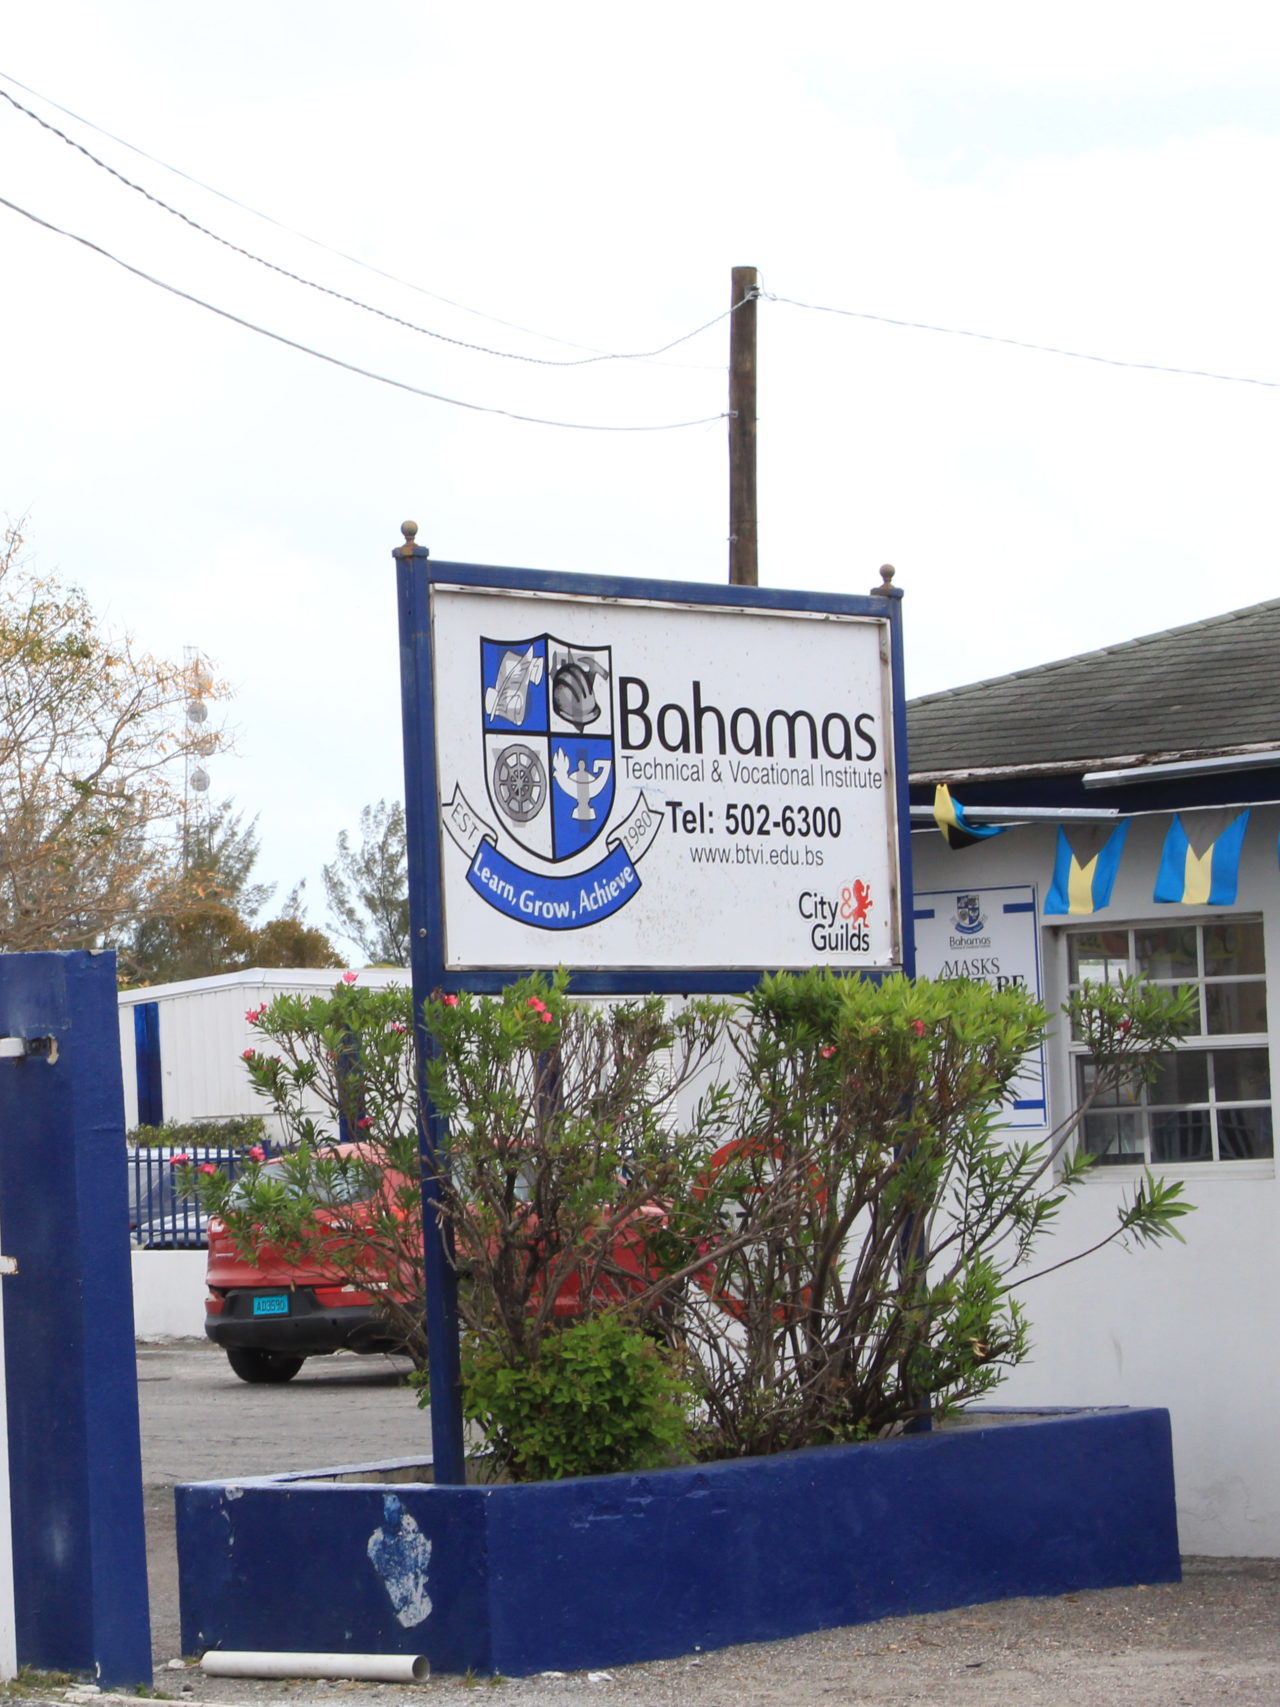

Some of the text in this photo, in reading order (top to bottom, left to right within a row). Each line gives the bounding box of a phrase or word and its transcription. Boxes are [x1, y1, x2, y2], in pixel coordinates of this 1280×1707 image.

[618, 676, 878, 762] Bahamas
[621, 756, 883, 790] Technical & Vocational Institute
[451, 803, 480, 848] EST.
[623, 810, 653, 852] 1980
[665, 800, 842, 838] Tel: 502-6300
[689, 843, 824, 867] www.btvi.edu.bs
[472, 852, 635, 920] Learn, Grow, Achieve
[798, 891, 839, 928] City
[811, 922, 870, 952] Guilds
[949, 936, 991, 947] Bahamas
[943, 957, 1000, 978] MASKS
